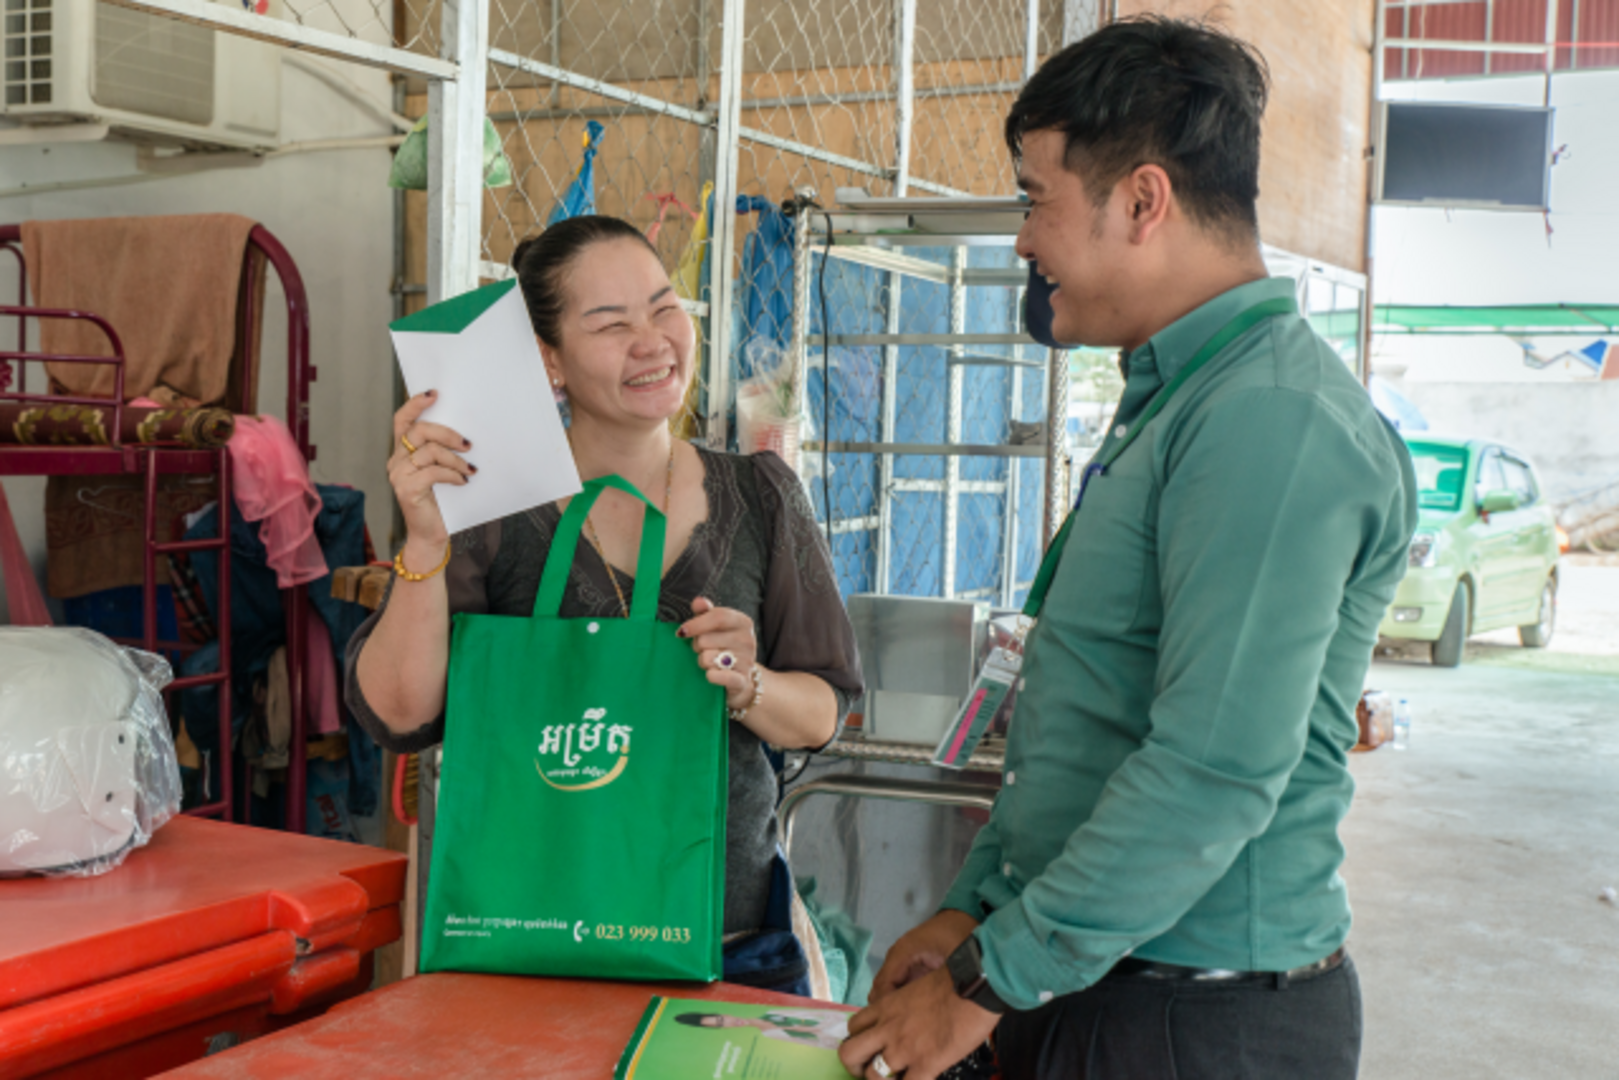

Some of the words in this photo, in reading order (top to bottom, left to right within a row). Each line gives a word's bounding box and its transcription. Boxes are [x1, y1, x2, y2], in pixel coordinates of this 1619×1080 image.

[596, 923, 625, 940] 023
[629, 925, 658, 942] 999
[662, 925, 692, 944] 033
